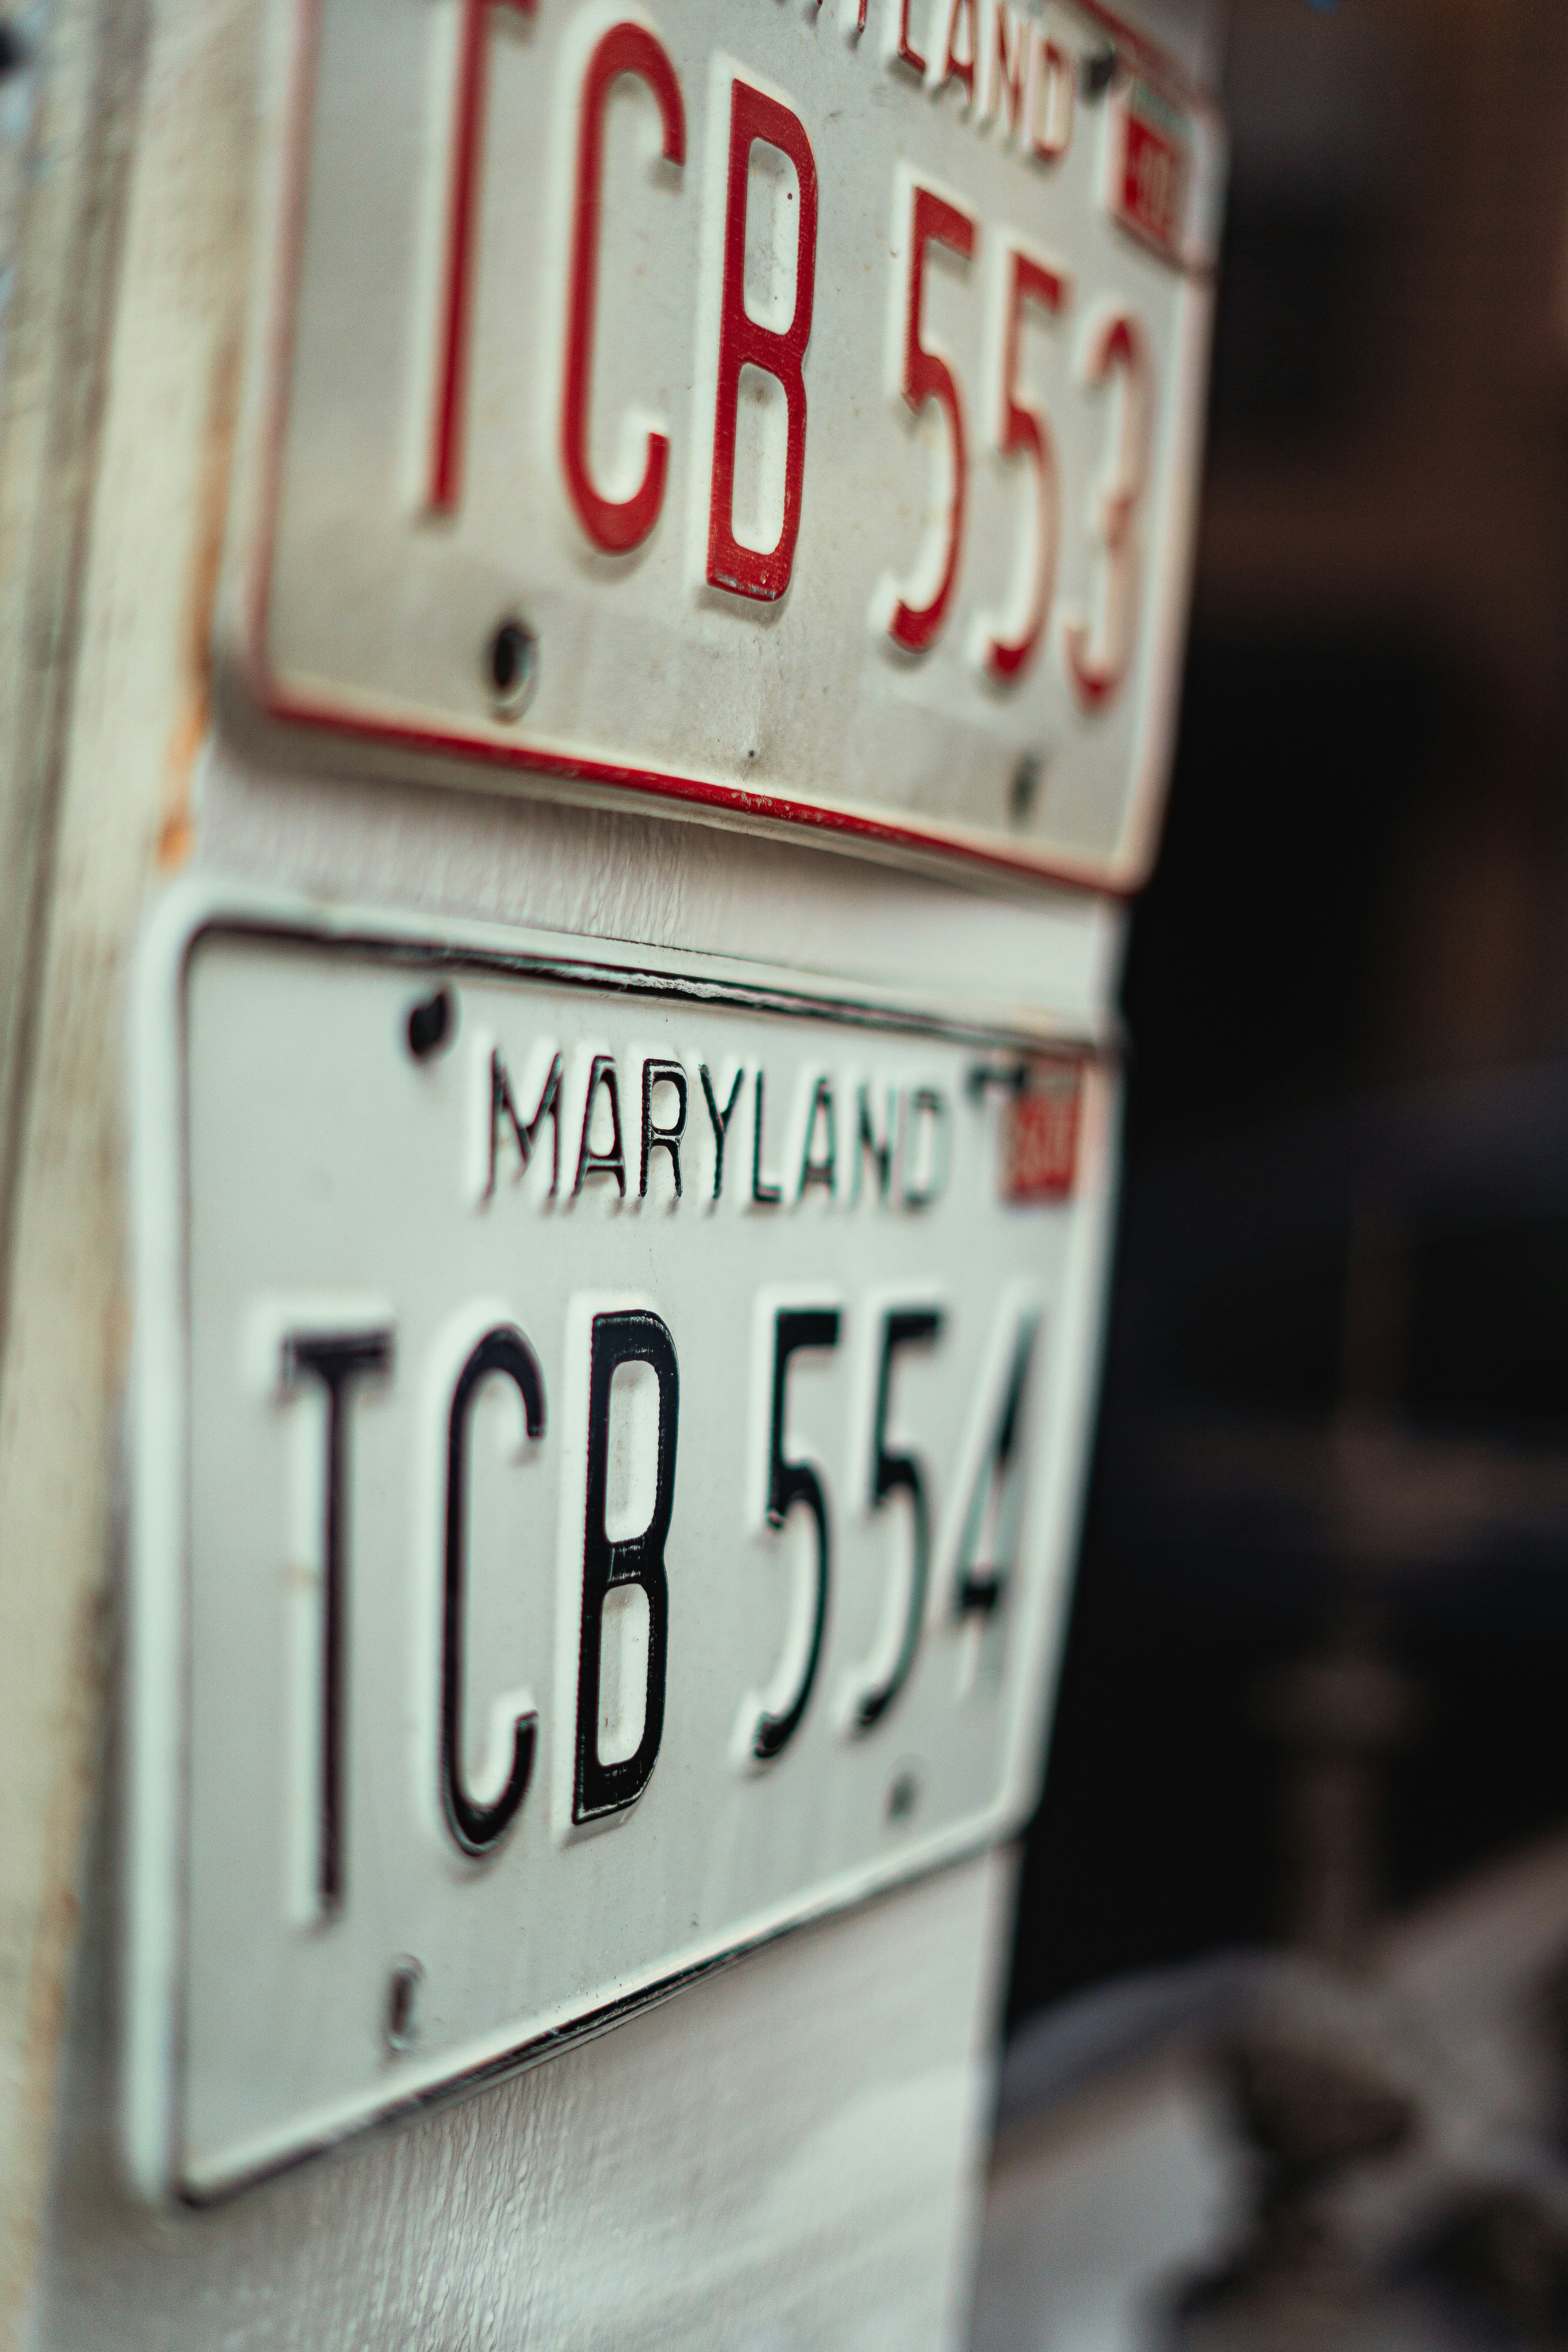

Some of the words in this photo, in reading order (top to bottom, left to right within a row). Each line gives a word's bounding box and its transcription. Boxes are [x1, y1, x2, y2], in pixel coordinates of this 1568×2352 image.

[815, 0, 1072, 161] LAND
[428, 0, 819, 601] TCB
[886, 186, 1152, 710] 553
[485, 1047, 949, 1203] MARYLAND
[282, 1307, 679, 1905] TCB
[753, 1307, 1037, 1758] 554
